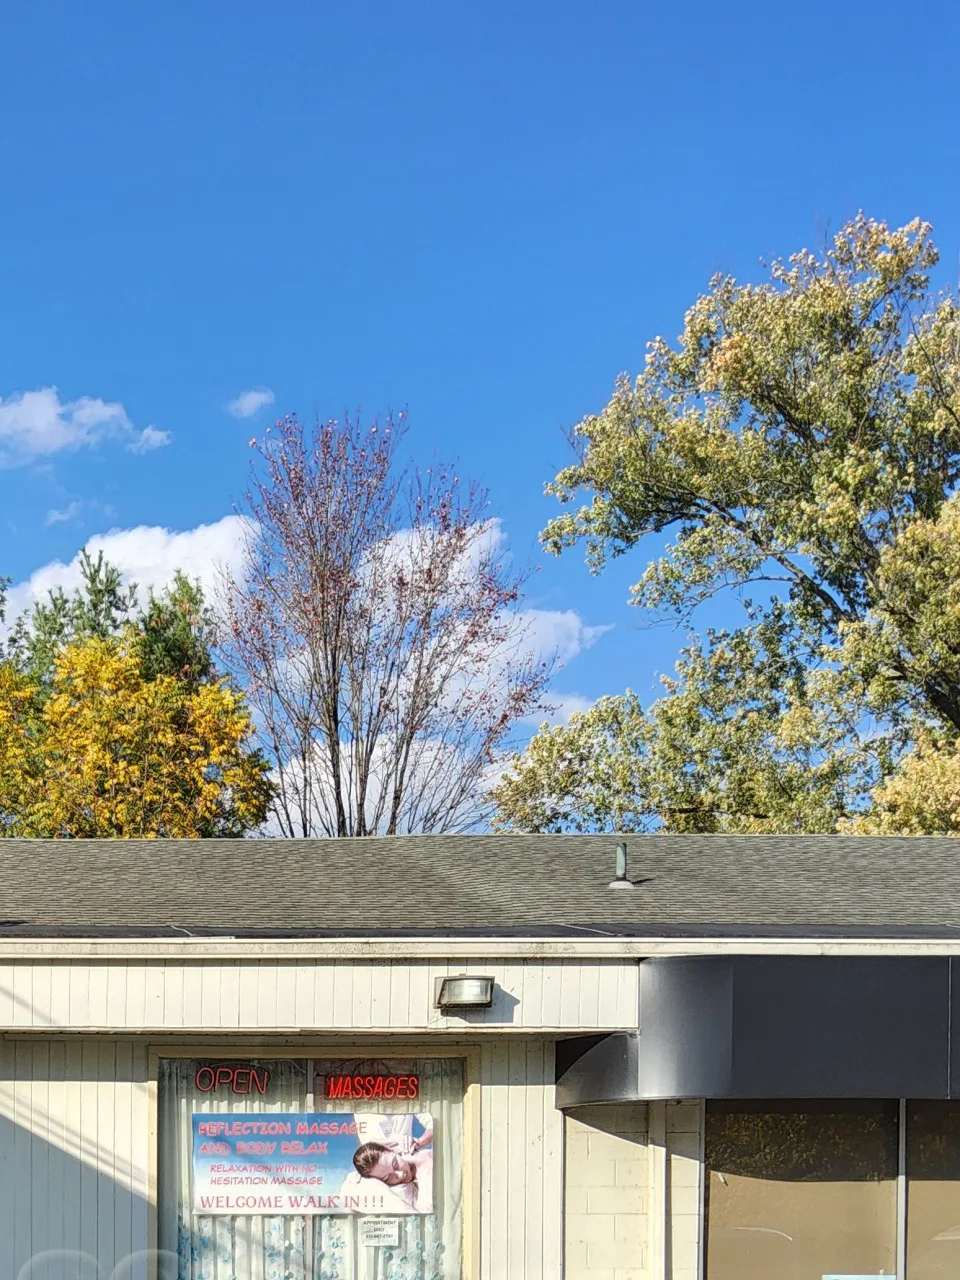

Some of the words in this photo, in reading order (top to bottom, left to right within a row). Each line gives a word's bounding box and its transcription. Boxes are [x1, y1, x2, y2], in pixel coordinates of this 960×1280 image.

[195, 1067, 269, 1095] OPEN
[328, 1076, 418, 1099] MASSAGES
[198, 1121, 291, 1136] REFLECTION
[296, 1121, 367, 1135] MASSAGE
[199, 1142, 231, 1155] AND
[236, 1141, 277, 1155] BODY
[280, 1141, 329, 1155] RELAX
[210, 1164, 272, 1173] RELAXATION
[275, 1164, 298, 1172] WITH
[301, 1164, 318, 1173] NO
[210, 1176, 268, 1185] HESITATION
[271, 1176, 323, 1185] MASSAGE
[288, 1195, 340, 1208] WALK
